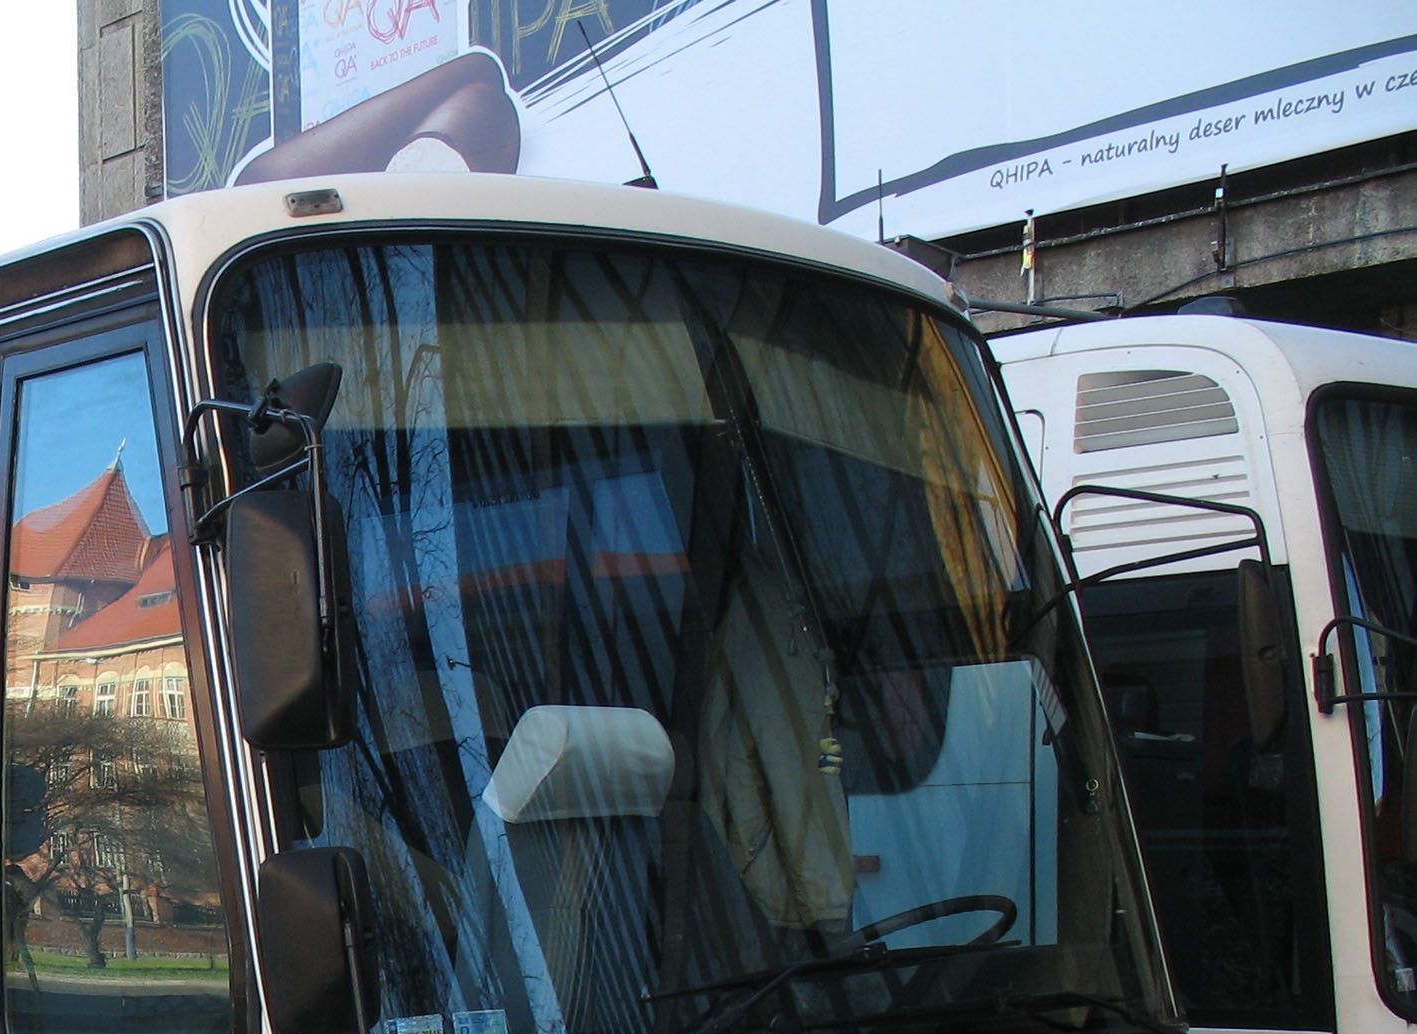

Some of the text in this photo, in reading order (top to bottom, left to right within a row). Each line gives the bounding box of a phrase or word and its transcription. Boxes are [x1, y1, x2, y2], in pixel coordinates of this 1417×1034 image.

[389, 52, 399, 63] TO
[990, 158, 1053, 189] QHIPA
[1081, 129, 1180, 167] naturalny
[1189, 113, 1246, 141] deser
[1254, 90, 1344, 126] mleczny
[1355, 80, 1375, 99] w
